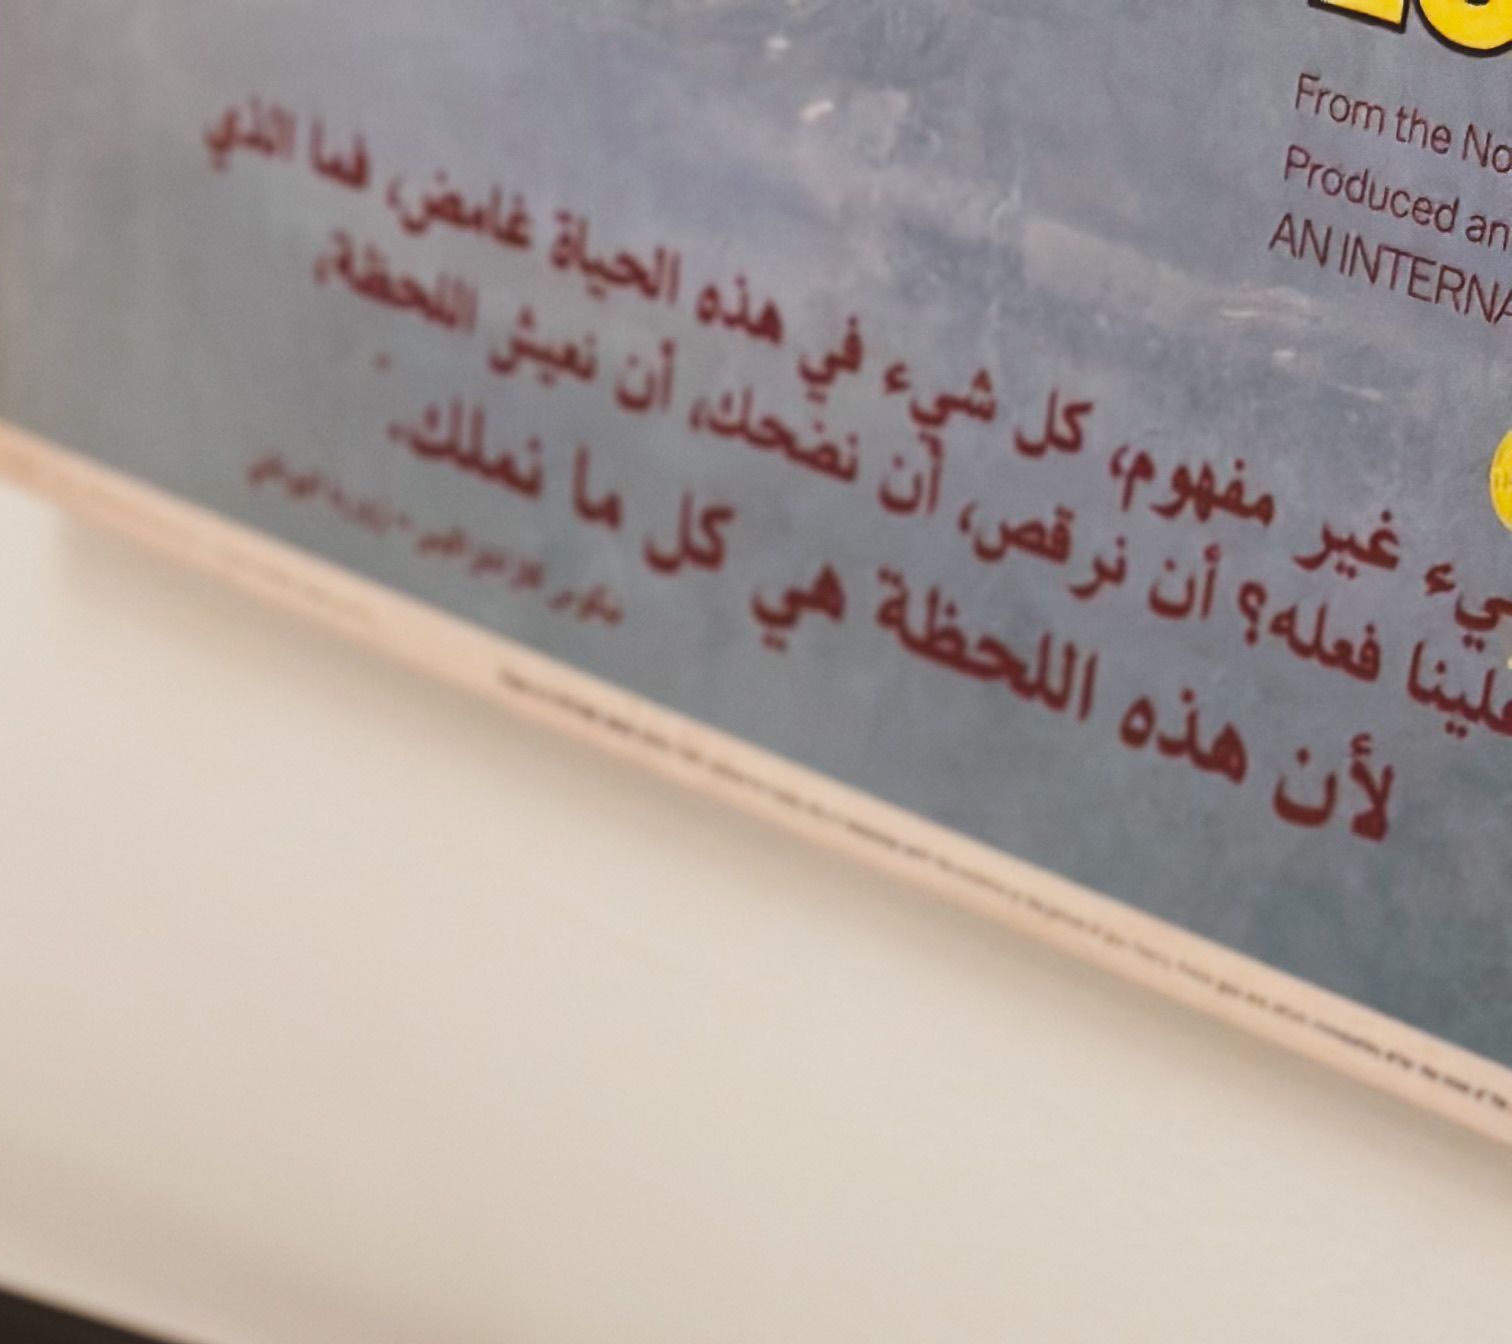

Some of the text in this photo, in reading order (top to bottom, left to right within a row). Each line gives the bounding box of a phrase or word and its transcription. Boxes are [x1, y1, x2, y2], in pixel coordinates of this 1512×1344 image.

[1296, 72, 1386, 135] From
[1395, 106, 1453, 155] the
[1284, 144, 1460, 234] Produced
[549, 209, 681, 305] الحياة
[1269, 212, 1332, 267] AN
[695, 277, 785, 348] هذه
[613, 337, 676, 416] أن
[797, 315, 865, 406] في
[882, 361, 999, 428] شيء
[1012, 388, 1095, 461] كل
[570, 445, 626, 534] ما
[876, 425, 942, 519] أن
[1109, 444, 1277, 530] مفهوم،
[641, 490, 741, 578] كل
[1291, 510, 1401, 580] غير
[748, 560, 850, 655] هي
[1146, 540, 1223, 624] أن
[1422, 561, 1512, 655] يء
[872, 563, 1100, 725] اللحظة
[1235, 578, 1385, 685] فعله؟
[1116, 686, 1250, 788] هذه
[1270, 730, 1399, 846] لأن
